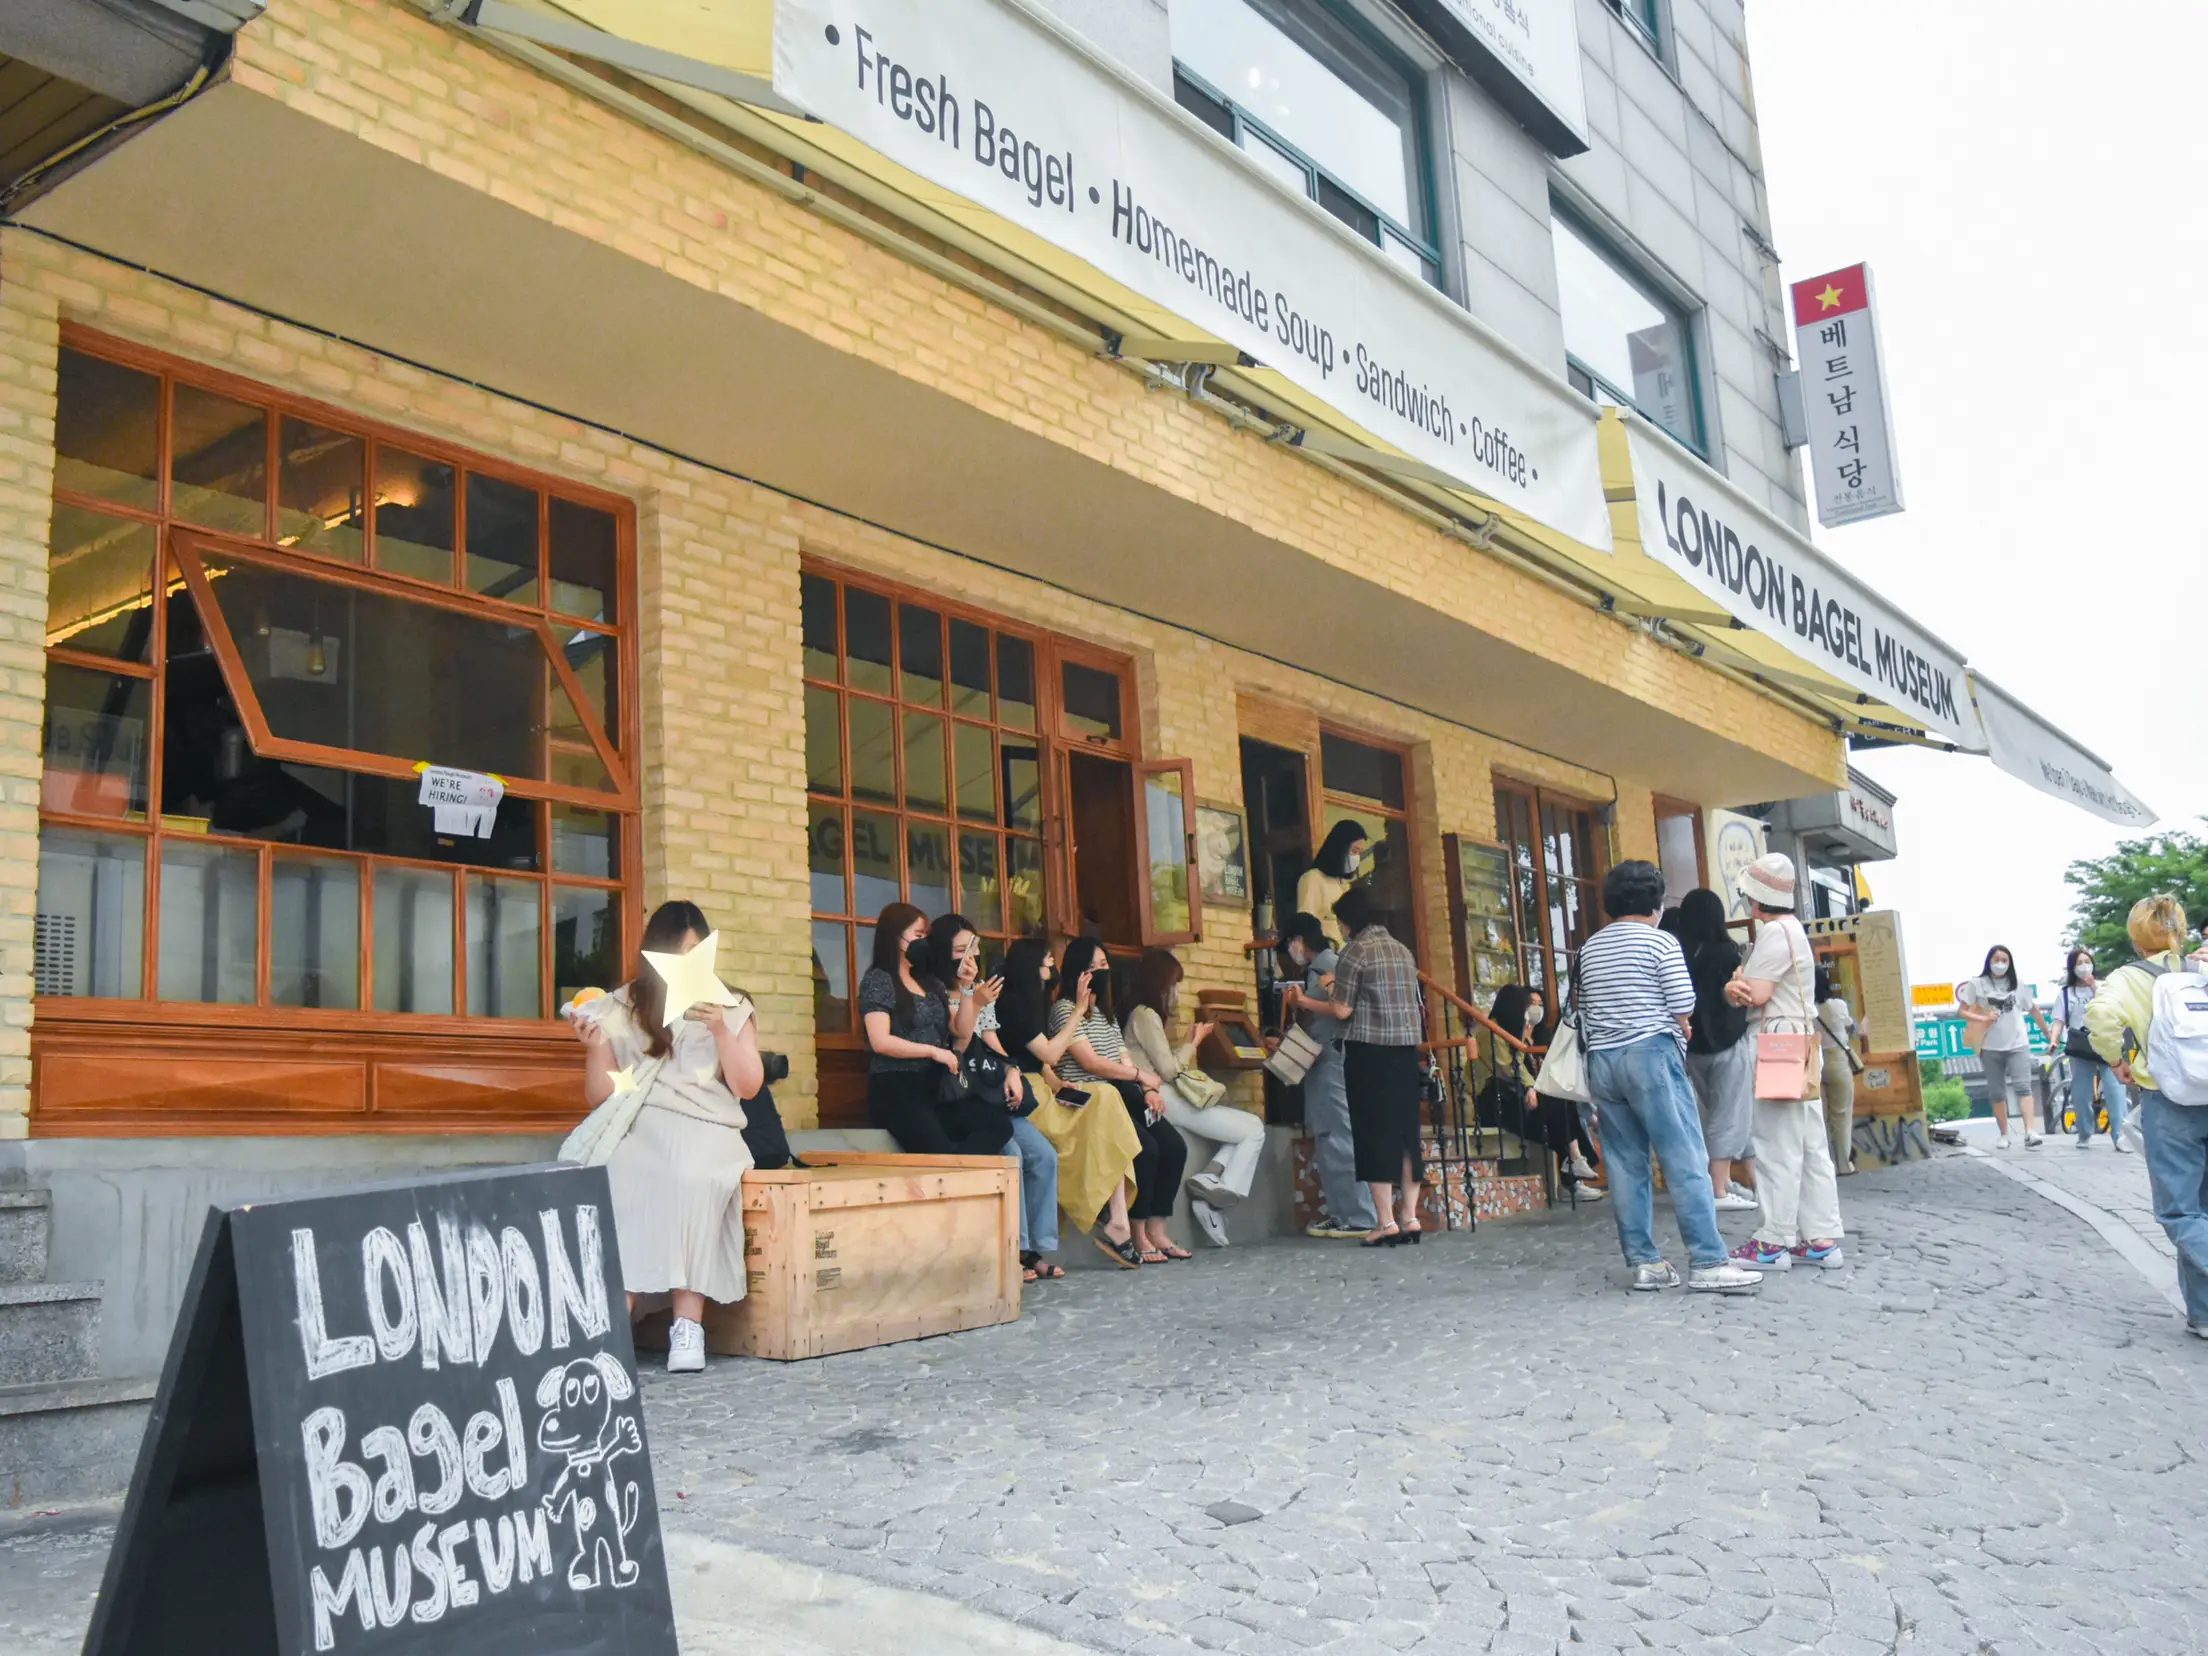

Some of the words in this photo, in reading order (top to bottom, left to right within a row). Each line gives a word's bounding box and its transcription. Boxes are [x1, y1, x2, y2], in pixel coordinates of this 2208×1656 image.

[855, 24, 959, 150] Fresh
[974, 99, 1074, 213] Bagel
[1112, 179, 1269, 333] Homemade
[1275, 292, 1334, 378] Soup
[1356, 342, 1454, 446] Sandwich
[1472, 416, 1527, 488] Coffee
[1657, 480, 1787, 626] LONDON
[1791, 573, 1872, 677] BAGEL
[1874, 627, 1961, 726] MUSEUM
[428, 790, 468, 805] HIRING!
[431, 776, 462, 791] WE'RE
[1920, 1037, 1939, 1047] Park
[290, 1204, 612, 1381] LONDON
[301, 1377, 529, 1549] Bagel
[311, 1507, 554, 1652] MUSEUM
